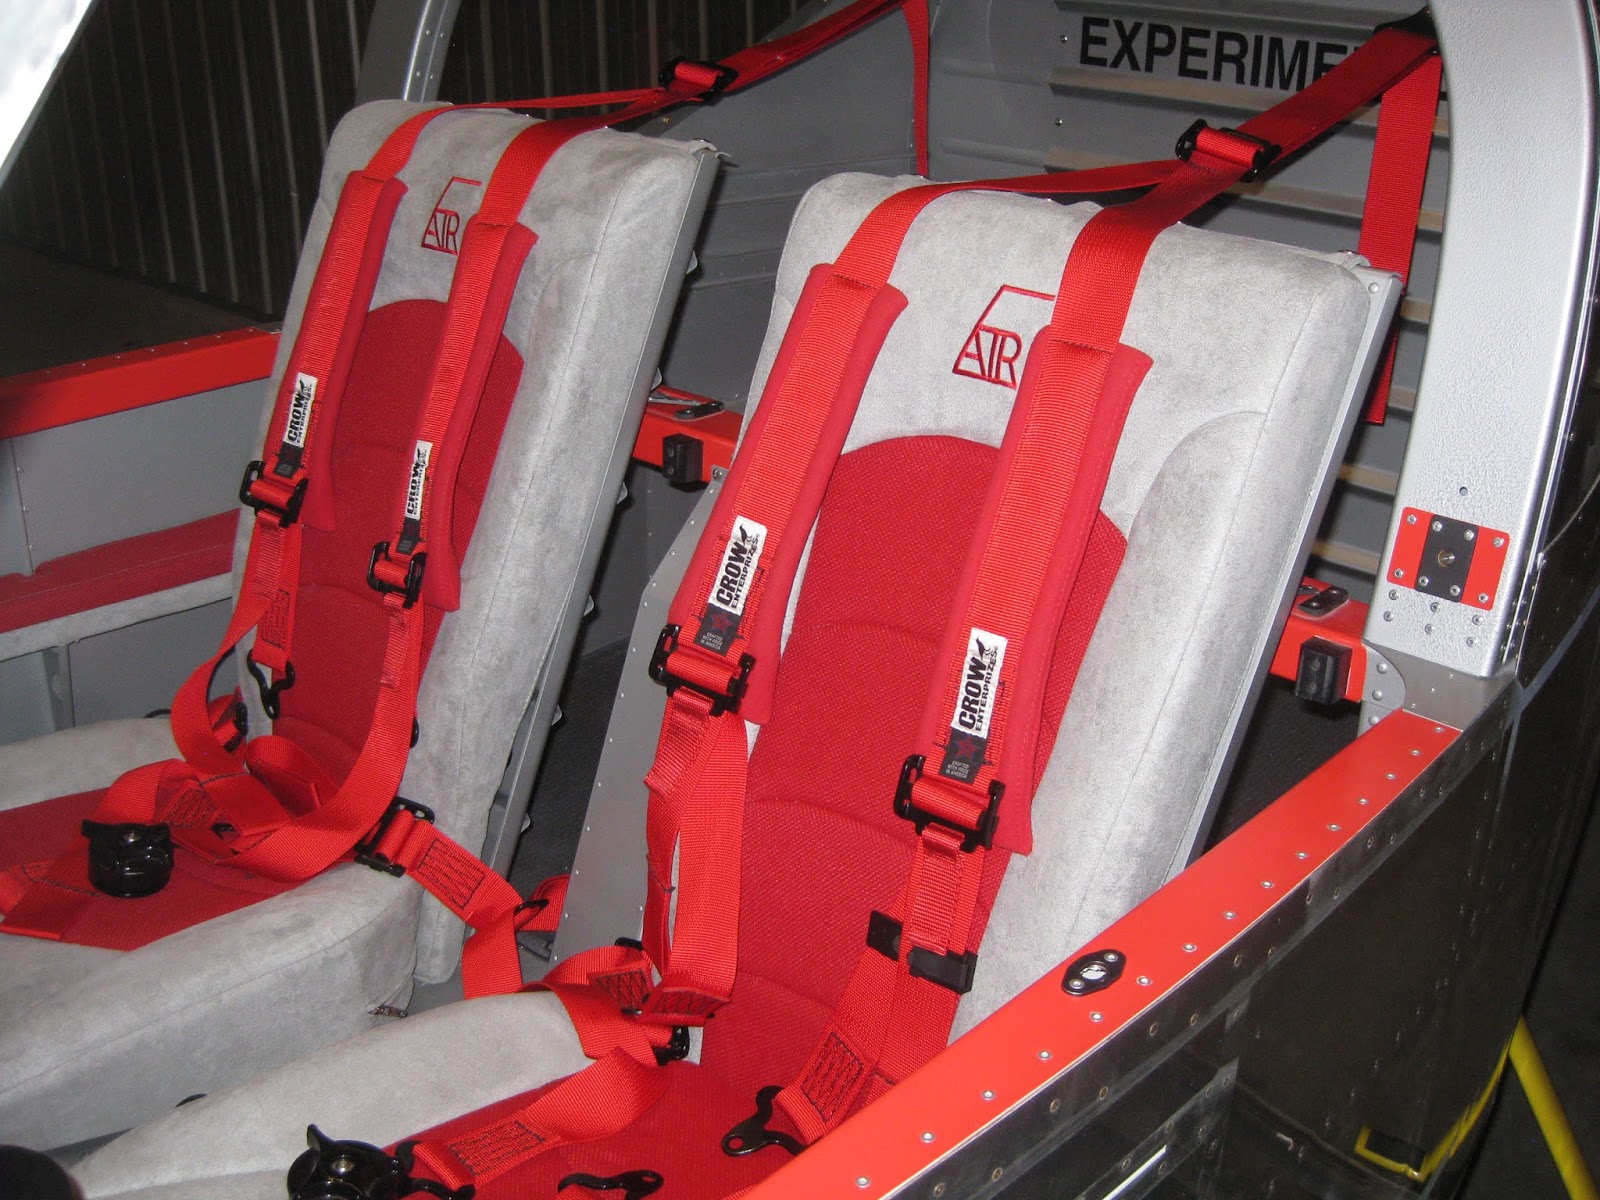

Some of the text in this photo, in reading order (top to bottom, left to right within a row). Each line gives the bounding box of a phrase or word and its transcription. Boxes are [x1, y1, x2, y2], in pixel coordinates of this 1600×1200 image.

[1079, 16, 1359, 92] EXPERIME
[286, 391, 306, 442] CROW
[406, 461, 421, 515] CROW
[716, 540, 748, 606] CROW
[731, 533, 760, 609] ENTERPRIZES
[958, 656, 987, 730] CROW
[975, 649, 998, 732] ENTERPRIZES
